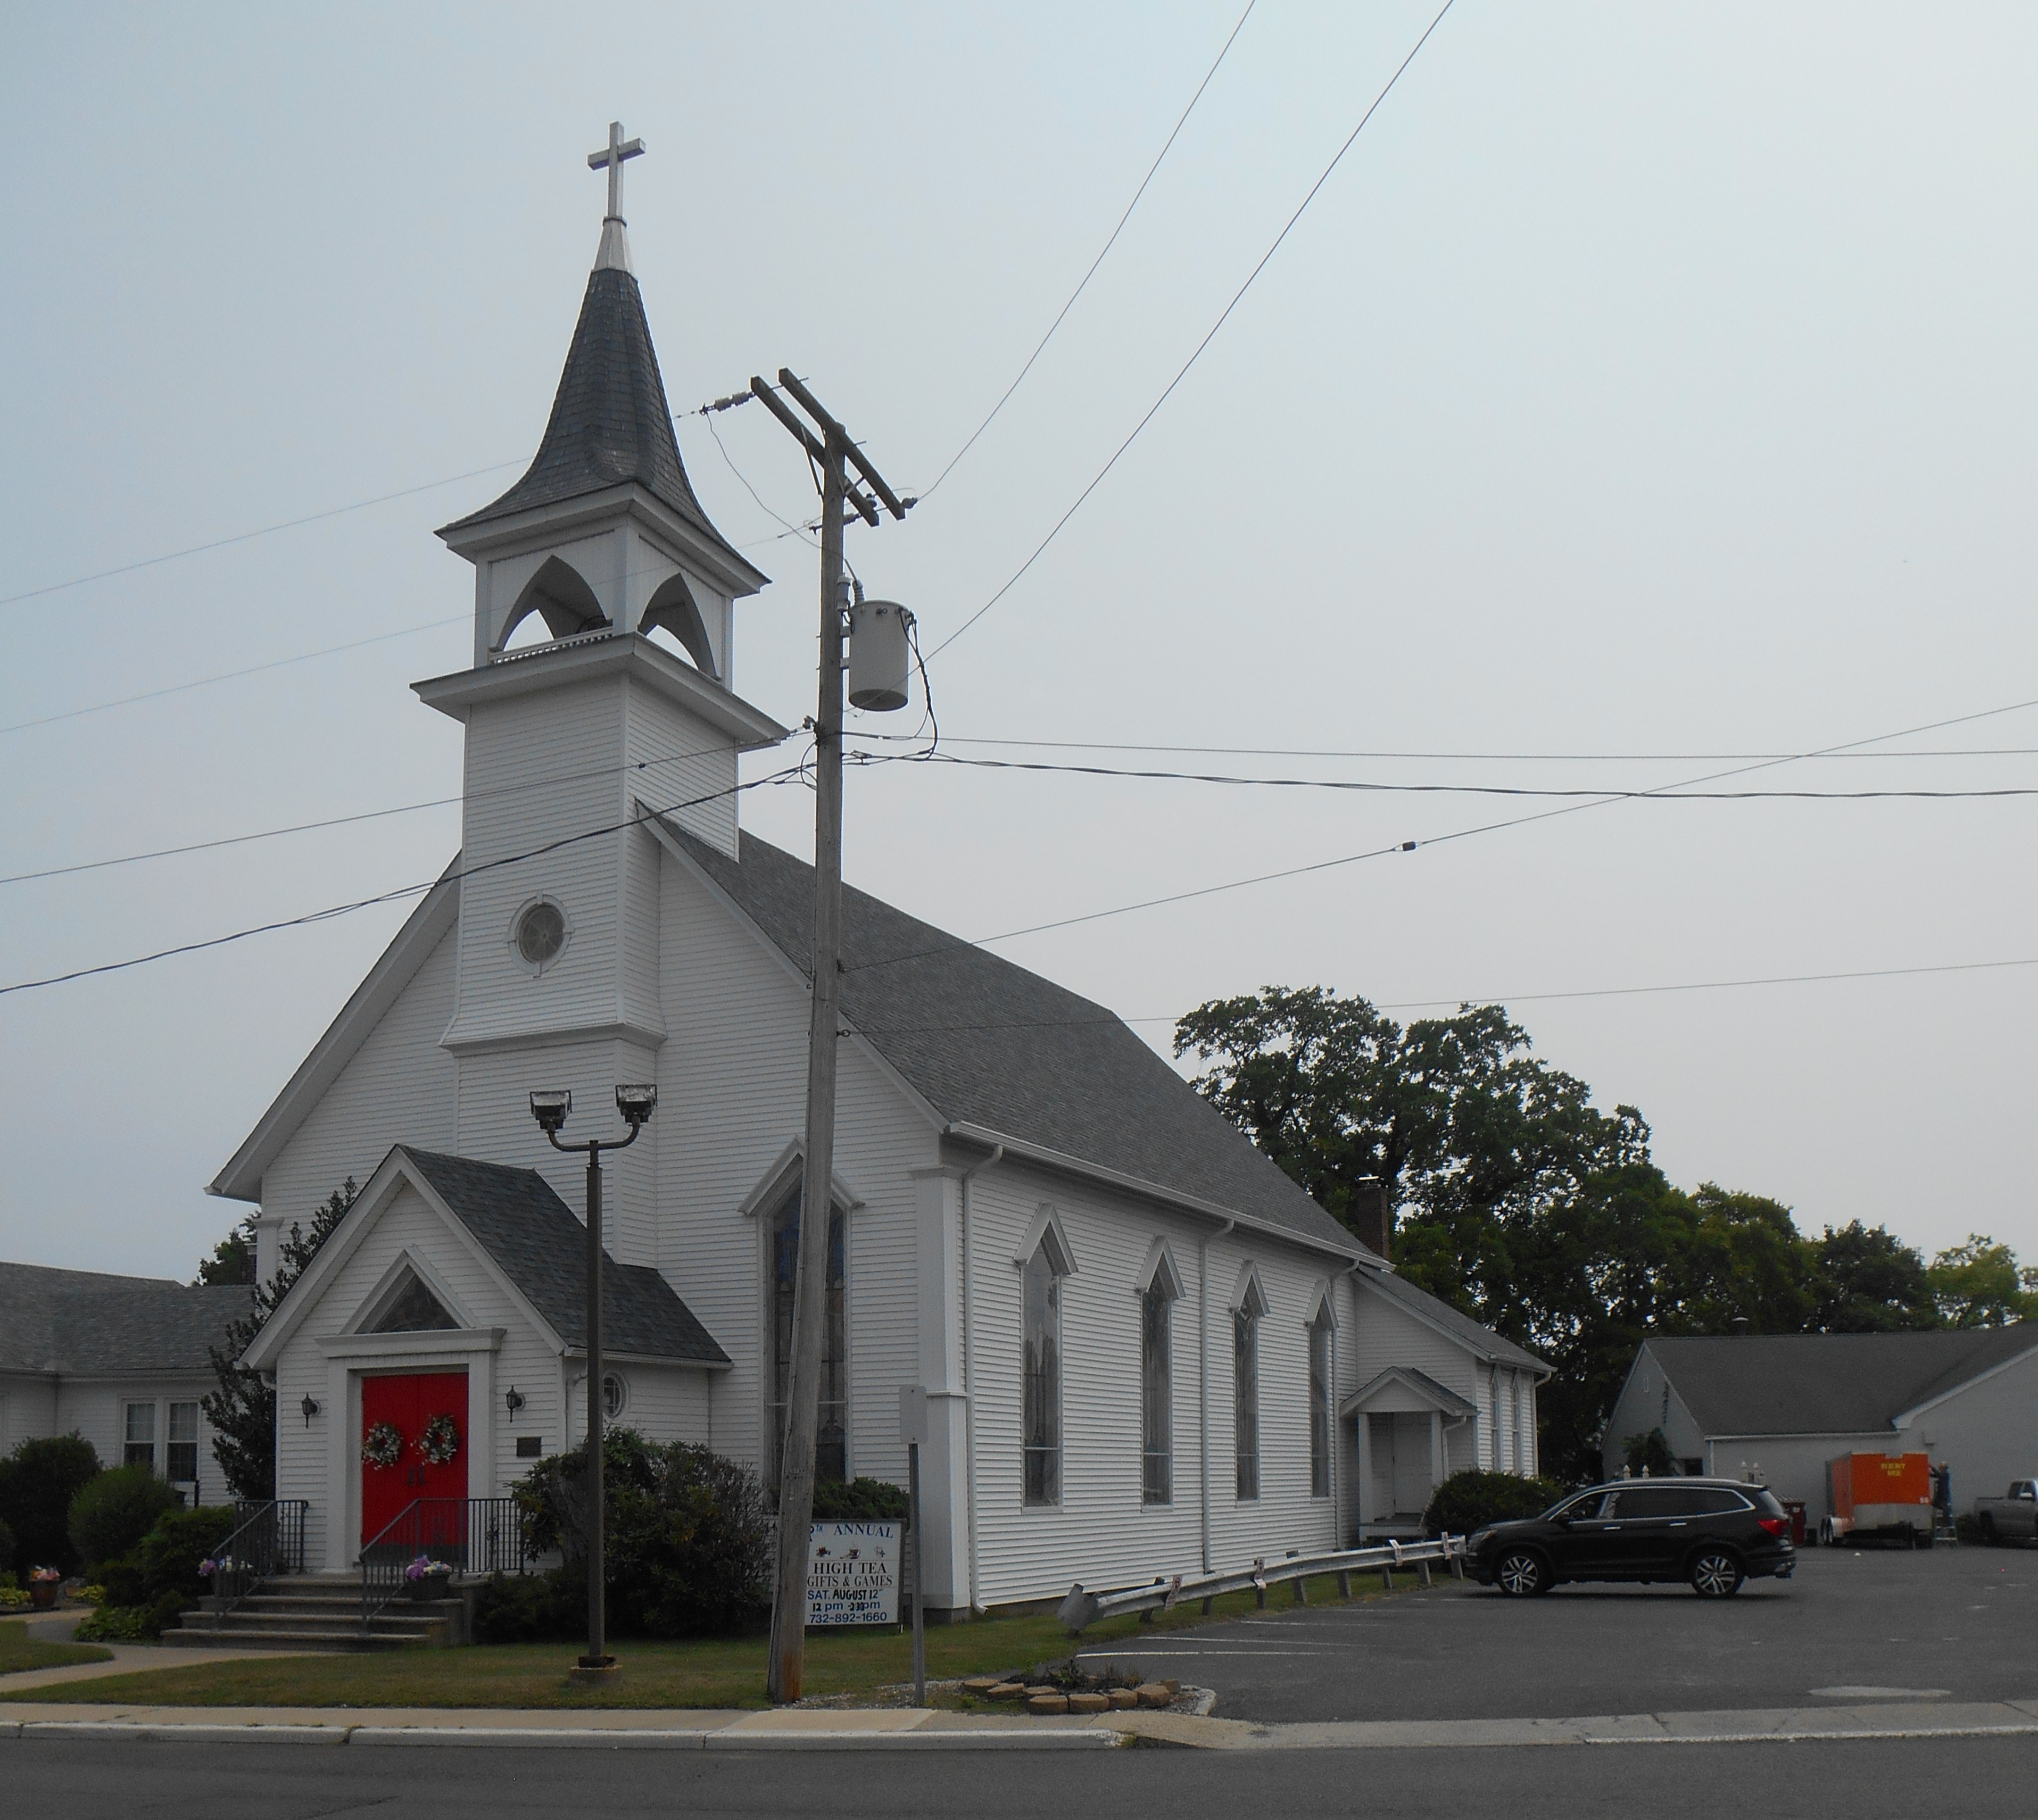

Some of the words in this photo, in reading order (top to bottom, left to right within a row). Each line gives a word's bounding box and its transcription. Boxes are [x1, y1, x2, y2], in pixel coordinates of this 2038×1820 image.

[834, 1524, 893, 1539] ANNUAL
[814, 1563, 852, 1574] HIGH
[859, 1562, 887, 1574] TEA
[807, 1575, 839, 1587] GIFTS
[842, 1576, 850, 1586] &
[855, 1575, 892, 1586] GAMES
[807, 1590, 830, 1600] SAT.
[832, 1589, 867, 1600] AUGUST
[813, 1603, 821, 1611] 12
[825, 1602, 843, 1612] pm
[809, 1611, 887, 1623] 732-892-1660
